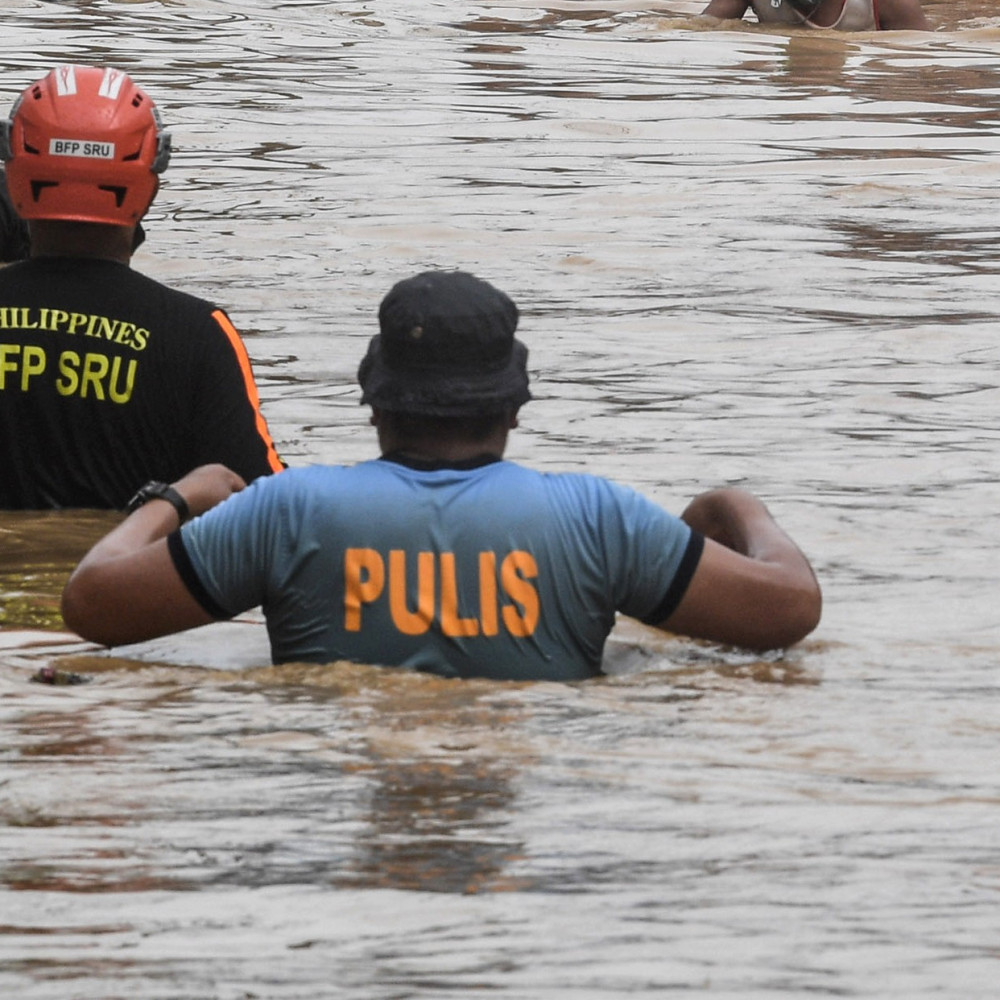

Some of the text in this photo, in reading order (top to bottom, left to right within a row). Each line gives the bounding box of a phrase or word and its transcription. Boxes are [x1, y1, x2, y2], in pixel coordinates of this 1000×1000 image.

[55, 141, 110, 156] BFP SRU
[56, 350, 138, 404] SRU
[344, 547, 540, 637] PULIS
